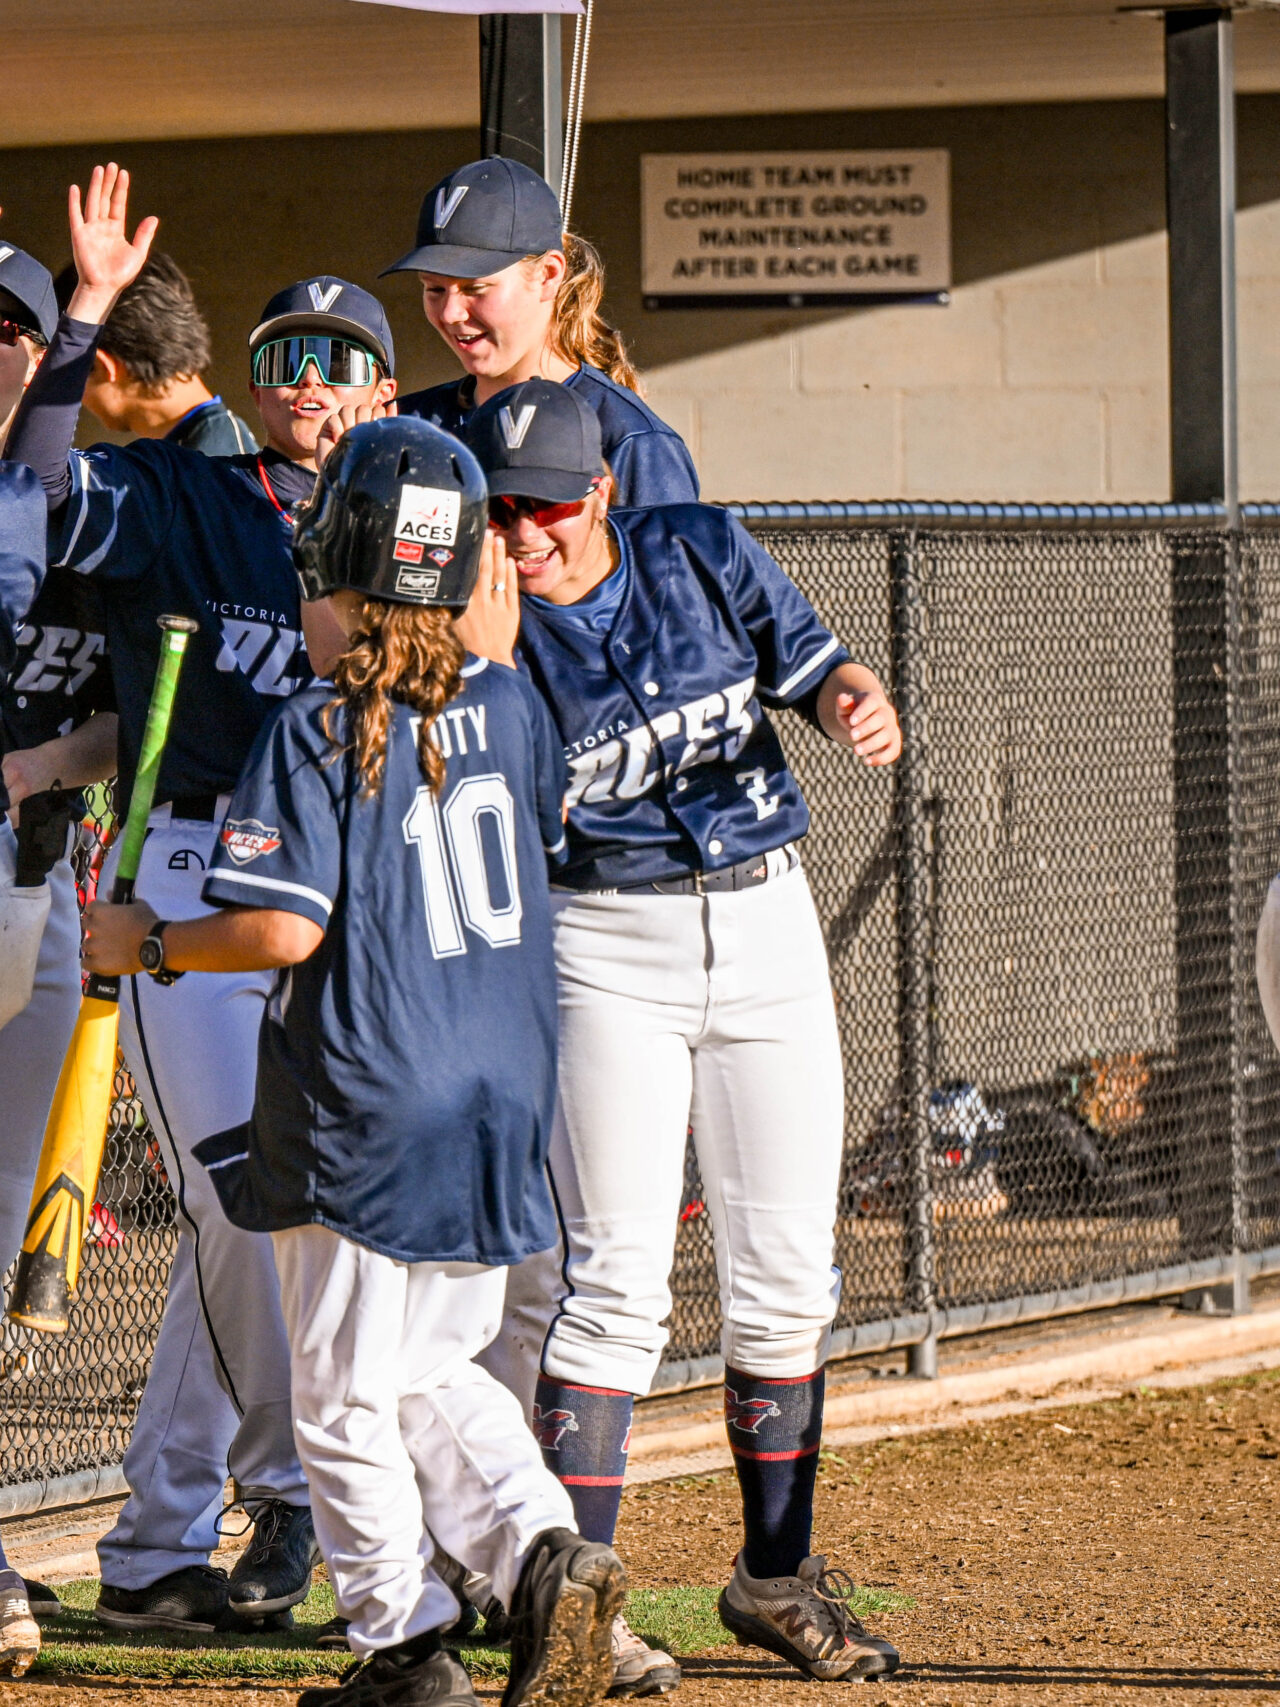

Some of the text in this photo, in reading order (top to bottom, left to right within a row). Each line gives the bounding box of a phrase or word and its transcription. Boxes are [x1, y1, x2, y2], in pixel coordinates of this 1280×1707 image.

[677, 164, 913, 188] HOME TEAM MUST
[434, 186, 469, 229] V
[664, 194, 928, 219] COMPLETE GROUND
[699, 225, 892, 248] MAINTENANCE
[672, 254, 919, 278] AFTER EACH GAME
[307, 283, 343, 312] V
[499, 405, 536, 449] V
[401, 521, 453, 541] ACES
[206, 600, 287, 625] ICTORIA
[736, 766, 780, 822] 2
[402, 773, 523, 960] 10
[772, 1603, 816, 1638] N
